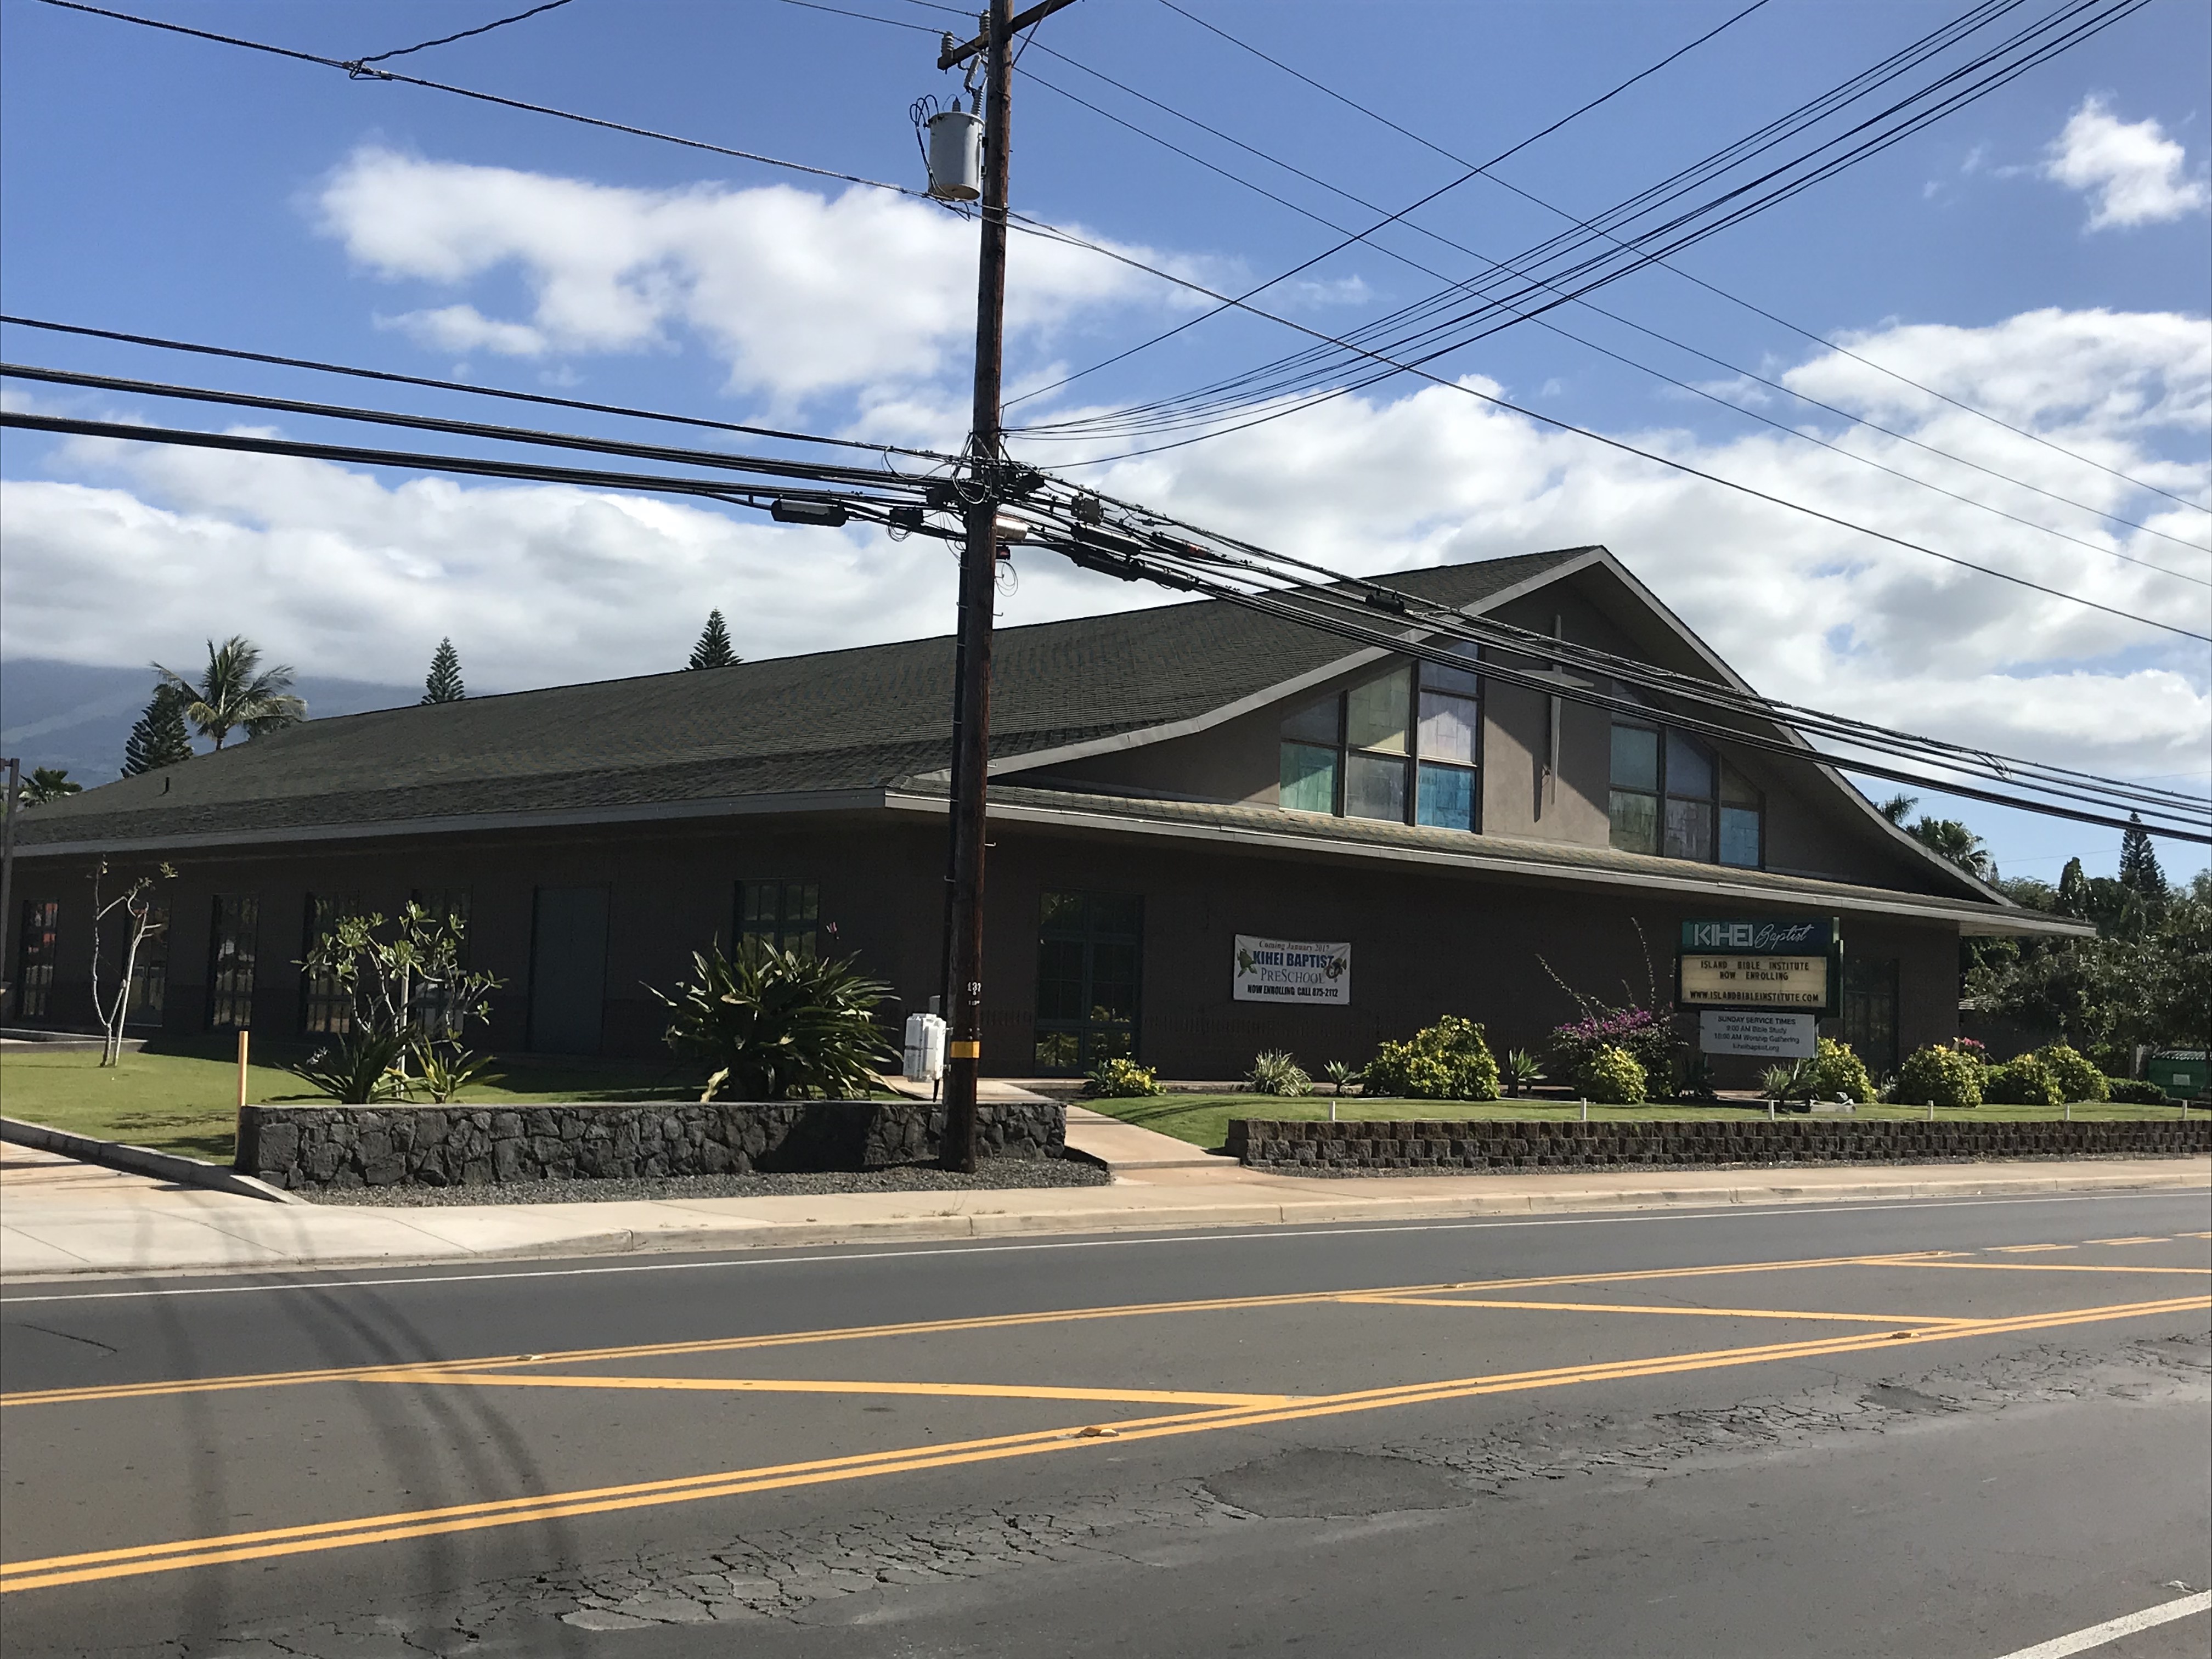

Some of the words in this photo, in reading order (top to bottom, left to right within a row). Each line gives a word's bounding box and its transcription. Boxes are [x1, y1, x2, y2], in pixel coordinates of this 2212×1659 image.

[1694, 924, 1753, 946] KIHEI
[1754, 923, 1814, 950] Baptist
[1259, 940, 1285, 951] Coming
[1287, 943, 1312, 951] January
[1253, 951, 1284, 966] KIHEI
[1286, 953, 1334, 968] BAPTIST
[1701, 961, 1728, 969] ISLAND
[1737, 961, 1760, 970] BIBLE
[1769, 962, 1809, 970] INSTITUTE
[1720, 971, 1736, 979] NOW
[1746, 972, 1788, 980] ENROLLING
[1247, 984, 1262, 994] NOW
[1263, 985, 1295, 996] ENROLLING
[1297, 986, 1311, 996] CALL
[1690, 991, 1819, 1002] WWW.ISLANDBIBLEINSTITUTECOM
[1769, 1035, 1800, 1045] Gathering
